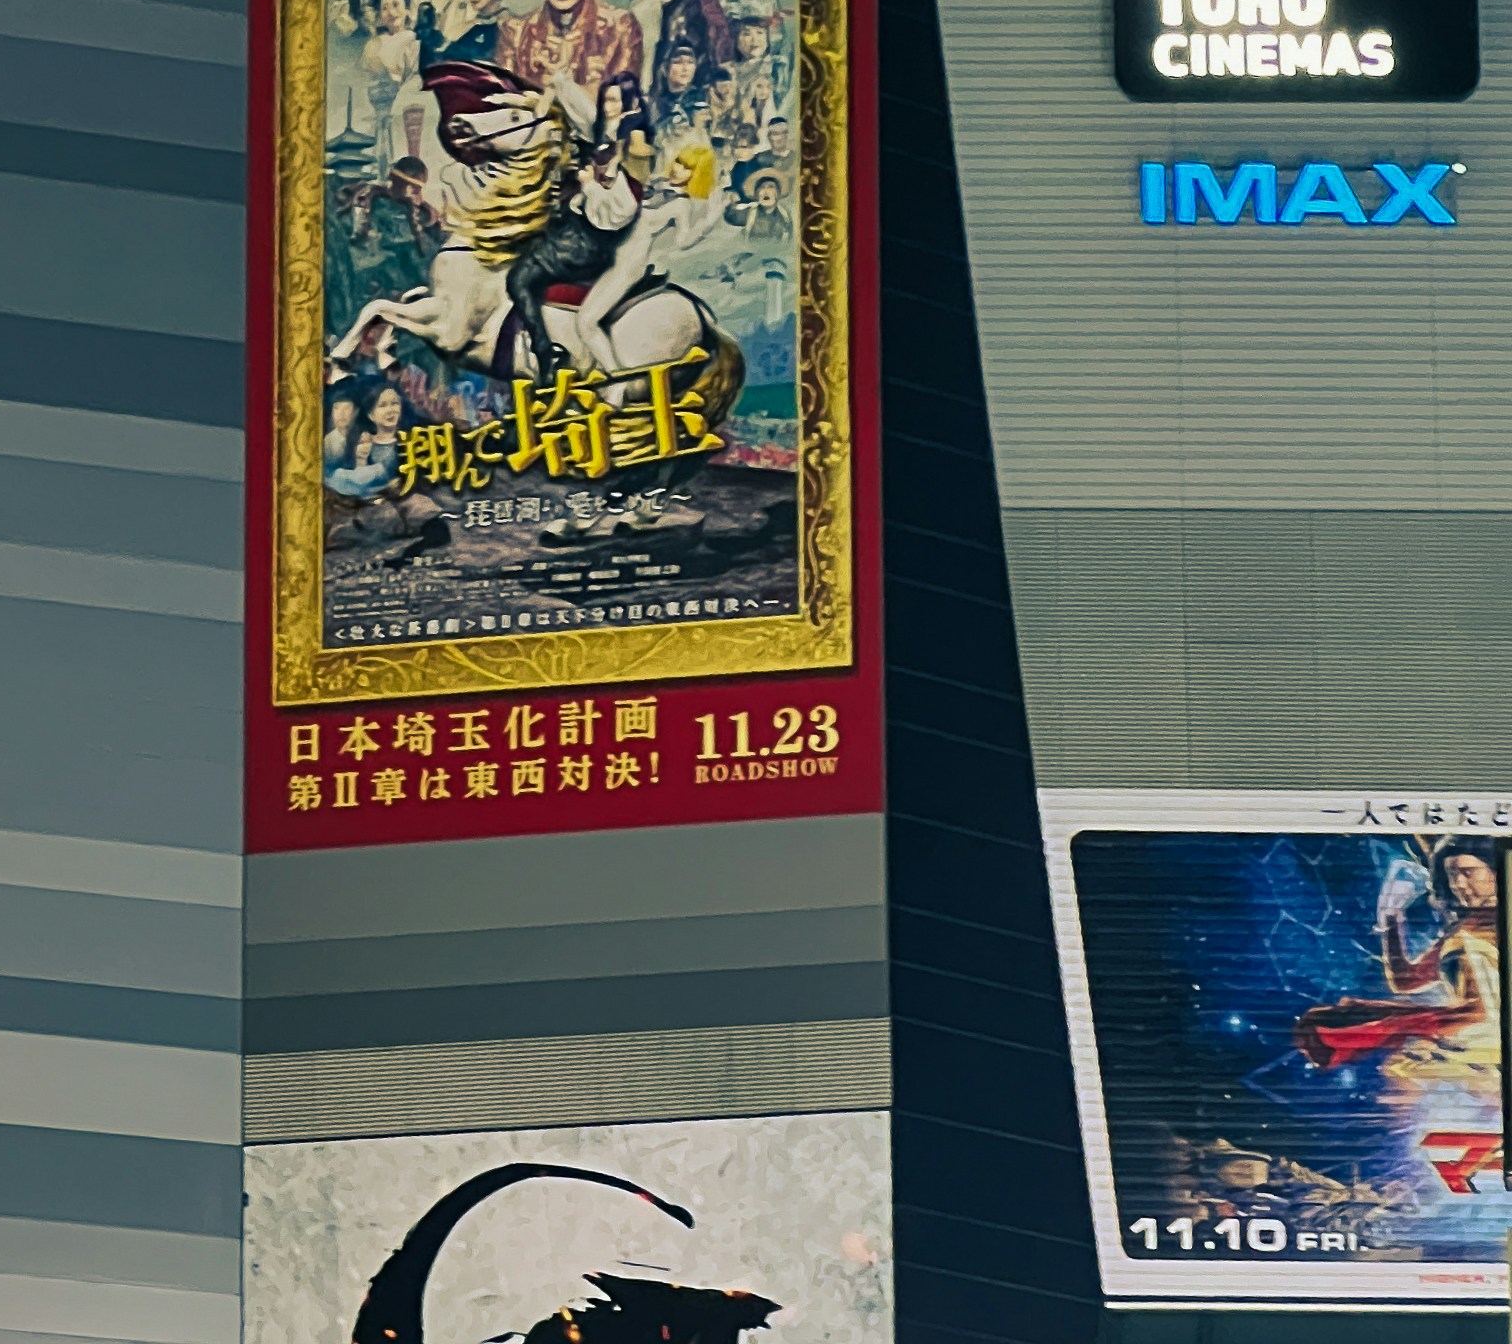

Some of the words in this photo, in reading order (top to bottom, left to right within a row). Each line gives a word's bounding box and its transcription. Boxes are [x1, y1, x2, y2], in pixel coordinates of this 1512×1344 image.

[1152, 31, 1396, 79] CINEMAS
[1140, 161, 1457, 226] IMAX
[290, 696, 659, 764] 日本埼玉化計画
[694, 704, 841, 761] 11.23
[695, 757, 839, 785] ROADSHOW
[1128, 1217, 1287, 1252] 11.10
